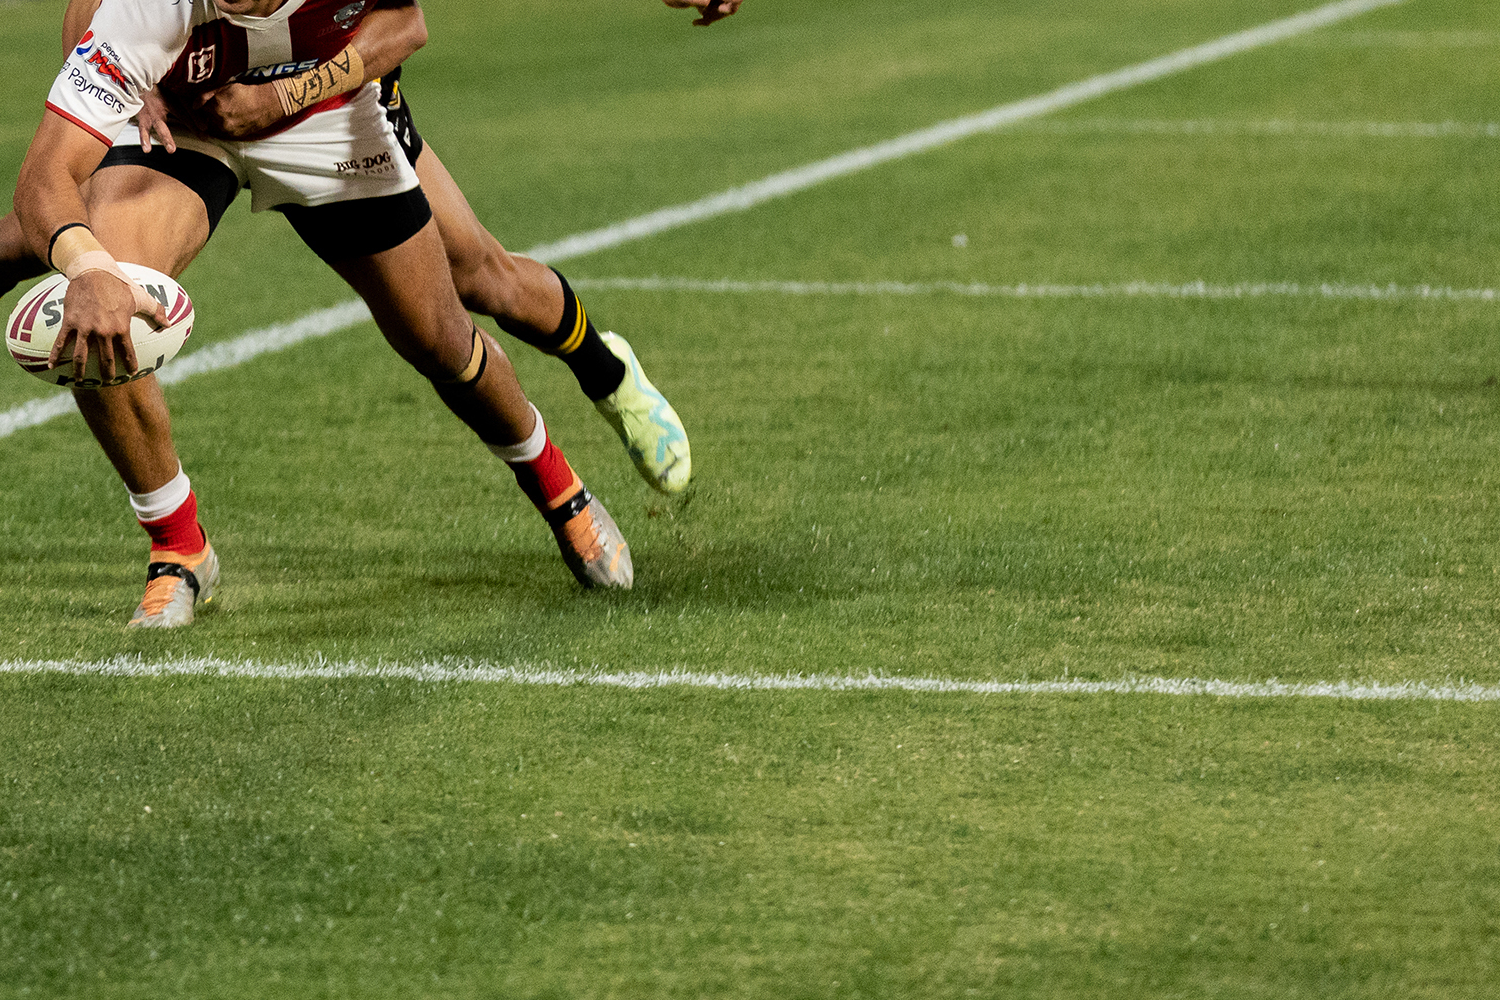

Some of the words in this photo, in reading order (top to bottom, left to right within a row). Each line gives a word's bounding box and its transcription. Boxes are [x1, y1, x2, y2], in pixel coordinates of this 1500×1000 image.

[101, 42, 121, 62] pepsi
[68, 67, 125, 114] Paynters
[333, 159, 360, 173] BIG
[362, 151, 391, 170] DOG
